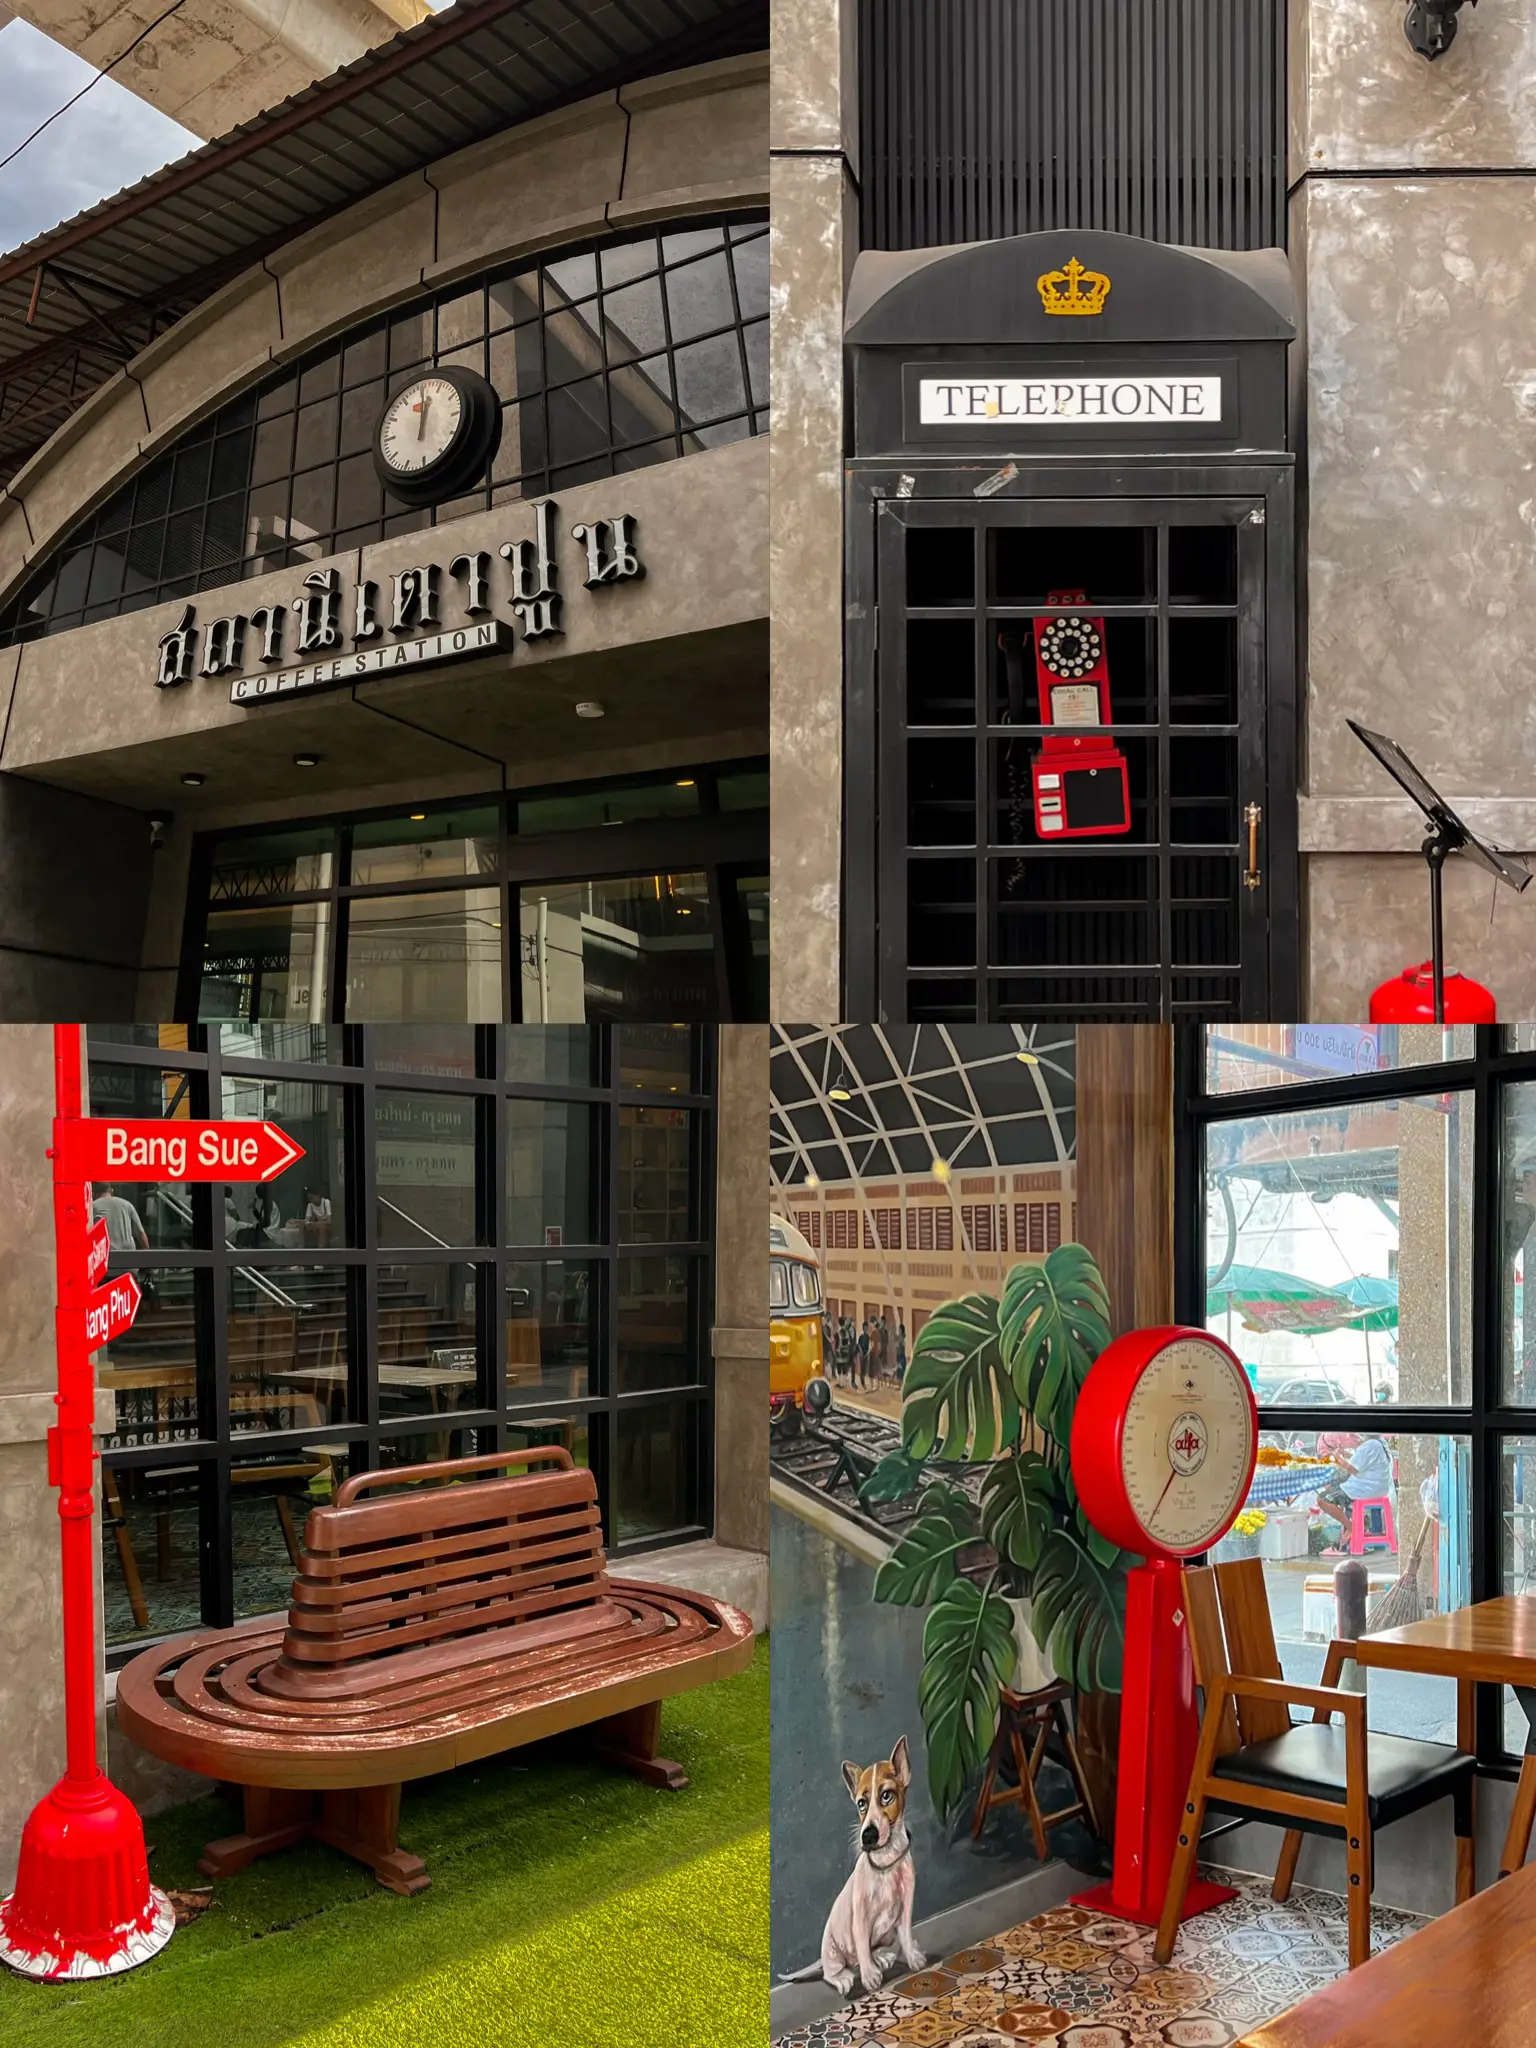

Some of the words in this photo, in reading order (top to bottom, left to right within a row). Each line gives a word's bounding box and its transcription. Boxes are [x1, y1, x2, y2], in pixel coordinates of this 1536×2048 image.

[936, 384, 1205, 418] TELEPHONE
[235, 661, 342, 698] COFFEE
[355, 625, 493, 673] STATION
[105, 1127, 187, 1178] Bang
[197, 1129, 259, 1167] Sue
[109, 1287, 131, 1326] Phu
[1174, 1428, 1200, 1459] alfa
